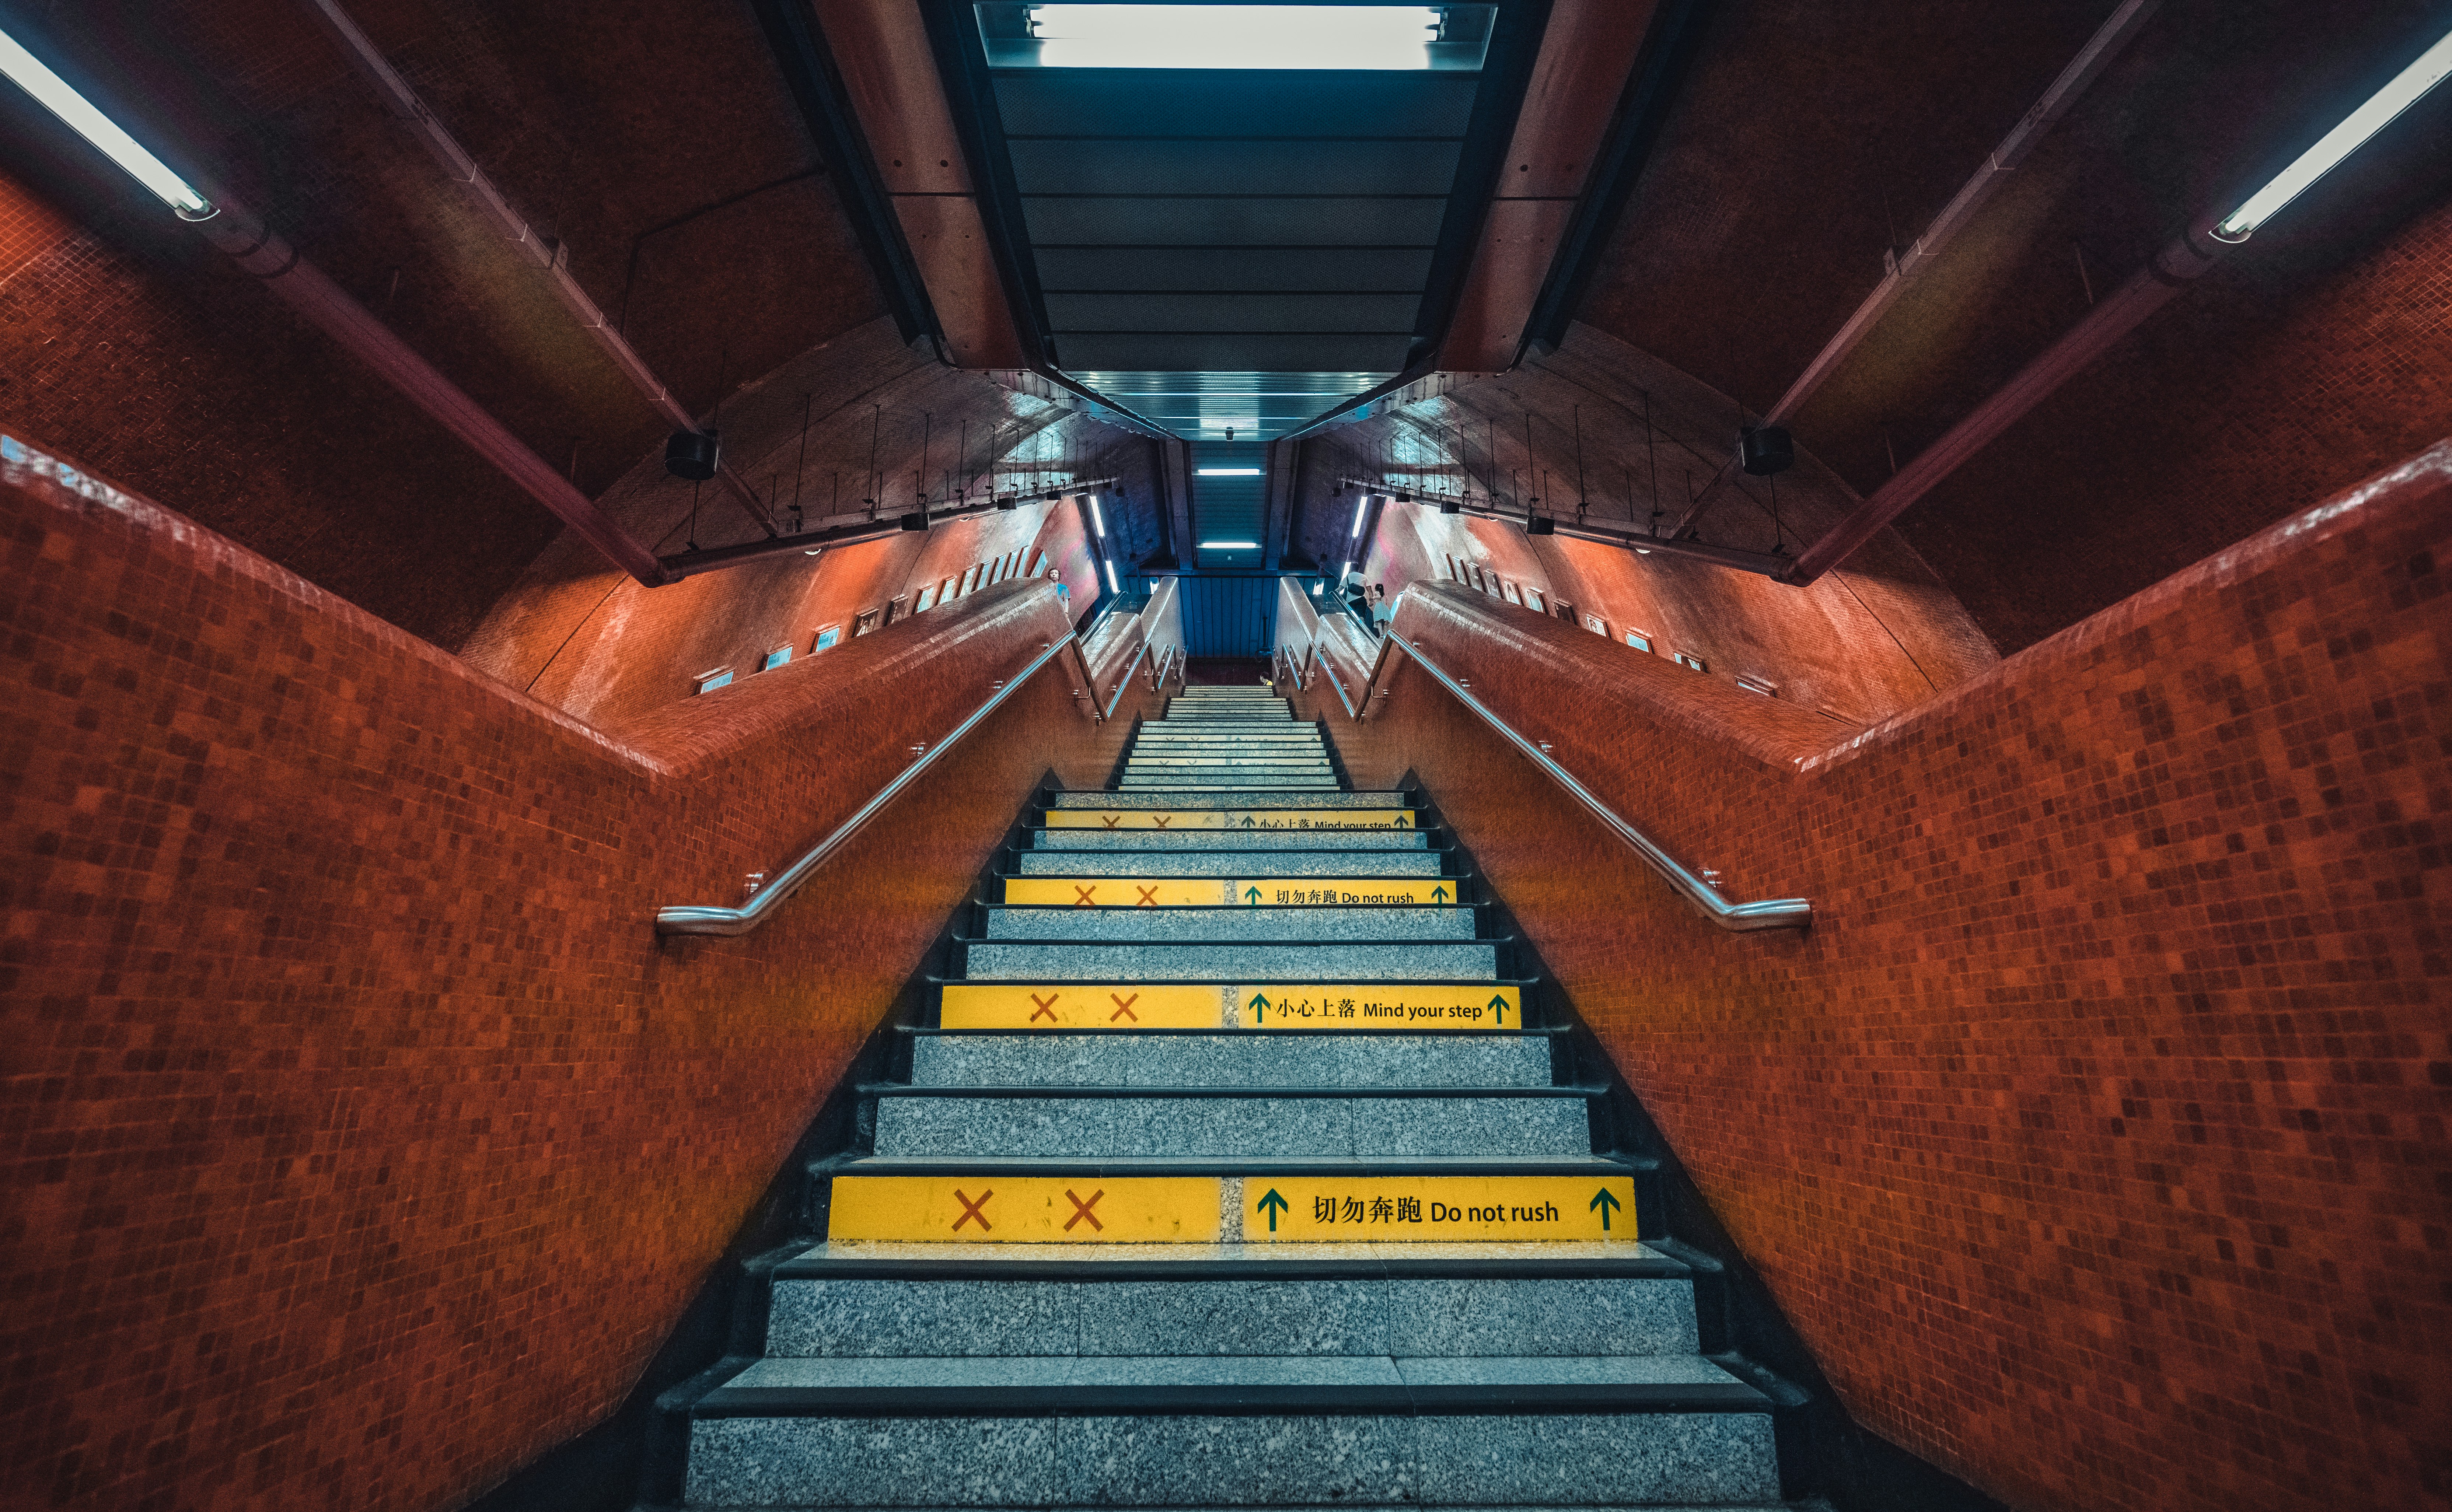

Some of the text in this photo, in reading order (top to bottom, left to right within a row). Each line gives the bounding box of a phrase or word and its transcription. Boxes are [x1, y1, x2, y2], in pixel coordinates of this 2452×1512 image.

[1275, 890, 1414, 904] 切勿奔跑 Do not rush
[1276, 999, 1482, 1021] 小心上落 Mind your step
[1313, 1196, 1558, 1224] 切勿奔跑 Do not rush
